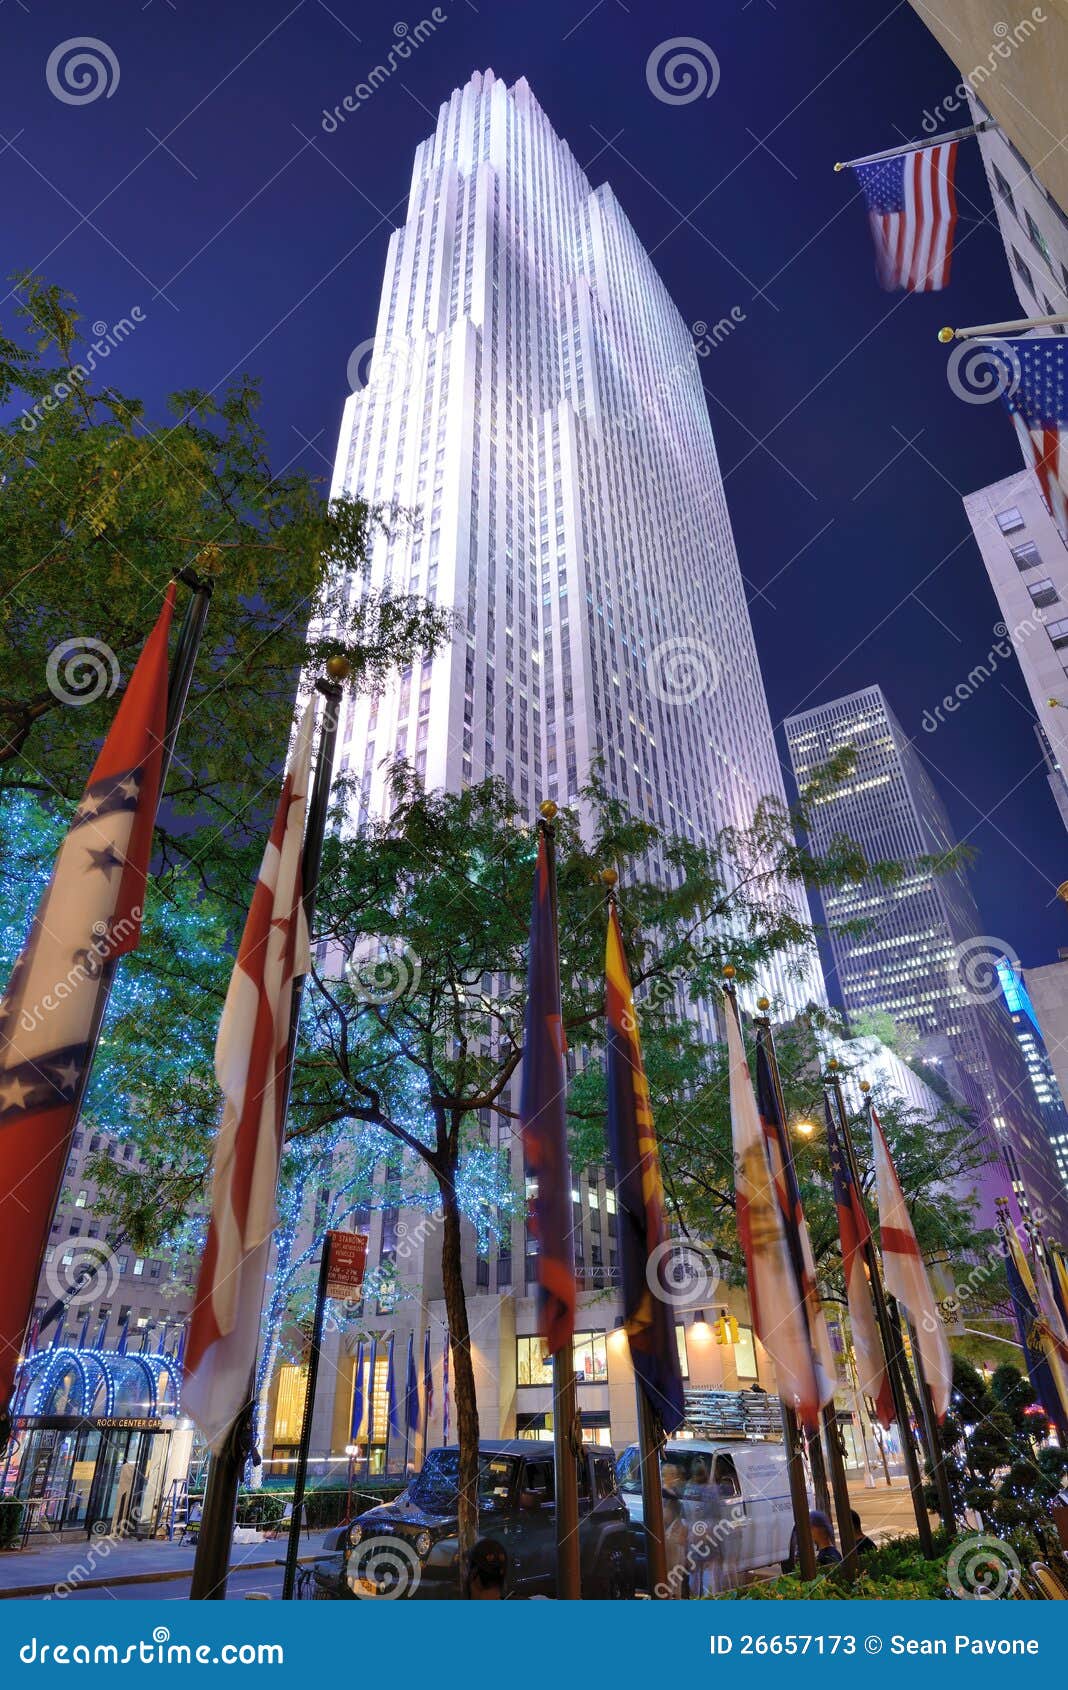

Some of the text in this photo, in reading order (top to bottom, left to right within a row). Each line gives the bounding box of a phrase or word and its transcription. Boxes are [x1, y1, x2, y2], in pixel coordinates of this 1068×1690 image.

[97, 1419, 163, 1428] ROCK CENTER CAF
